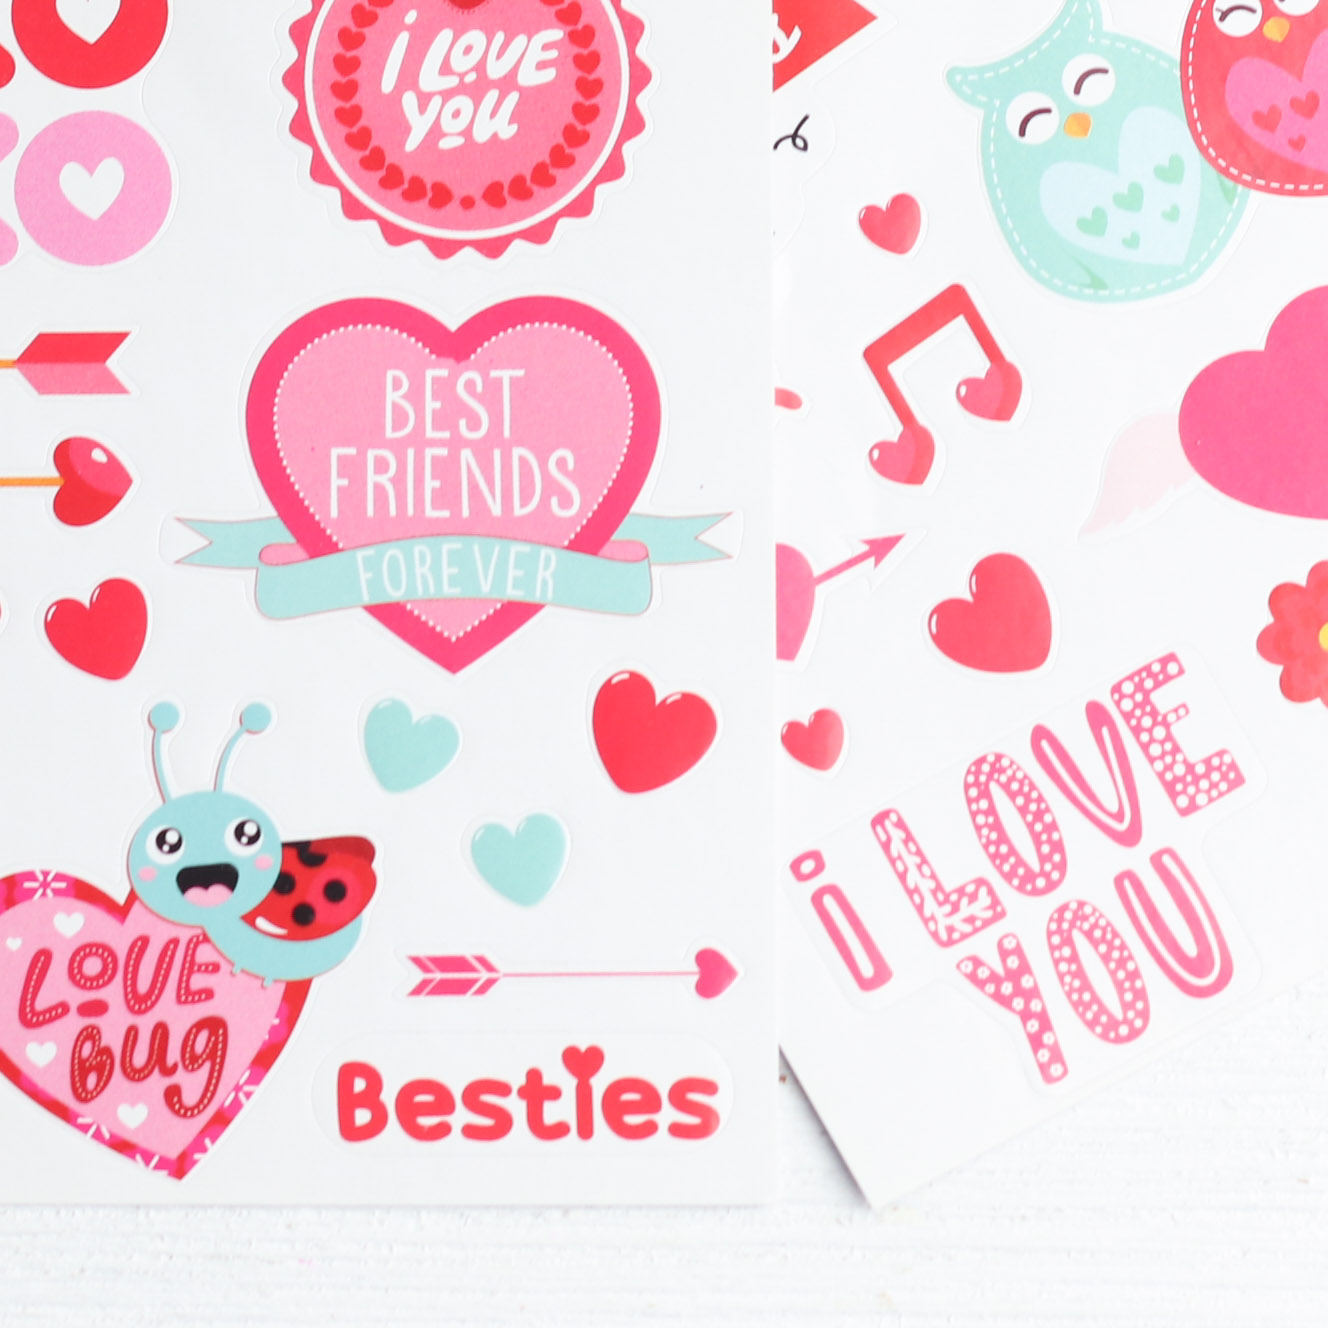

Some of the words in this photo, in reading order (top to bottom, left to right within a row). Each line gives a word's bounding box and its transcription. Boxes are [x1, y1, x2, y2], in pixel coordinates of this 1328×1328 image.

[418, 27, 564, 93] LOVE
[384, 368, 525, 440] BEST
[328, 446, 582, 518] FRIENDS
[355, 542, 558, 603] FOREVER
[869, 651, 1247, 949] LOVE
[17, 934, 221, 1030] LOVE
[955, 846, 1235, 1085] YOU
[337, 1044, 721, 1143] Besties
